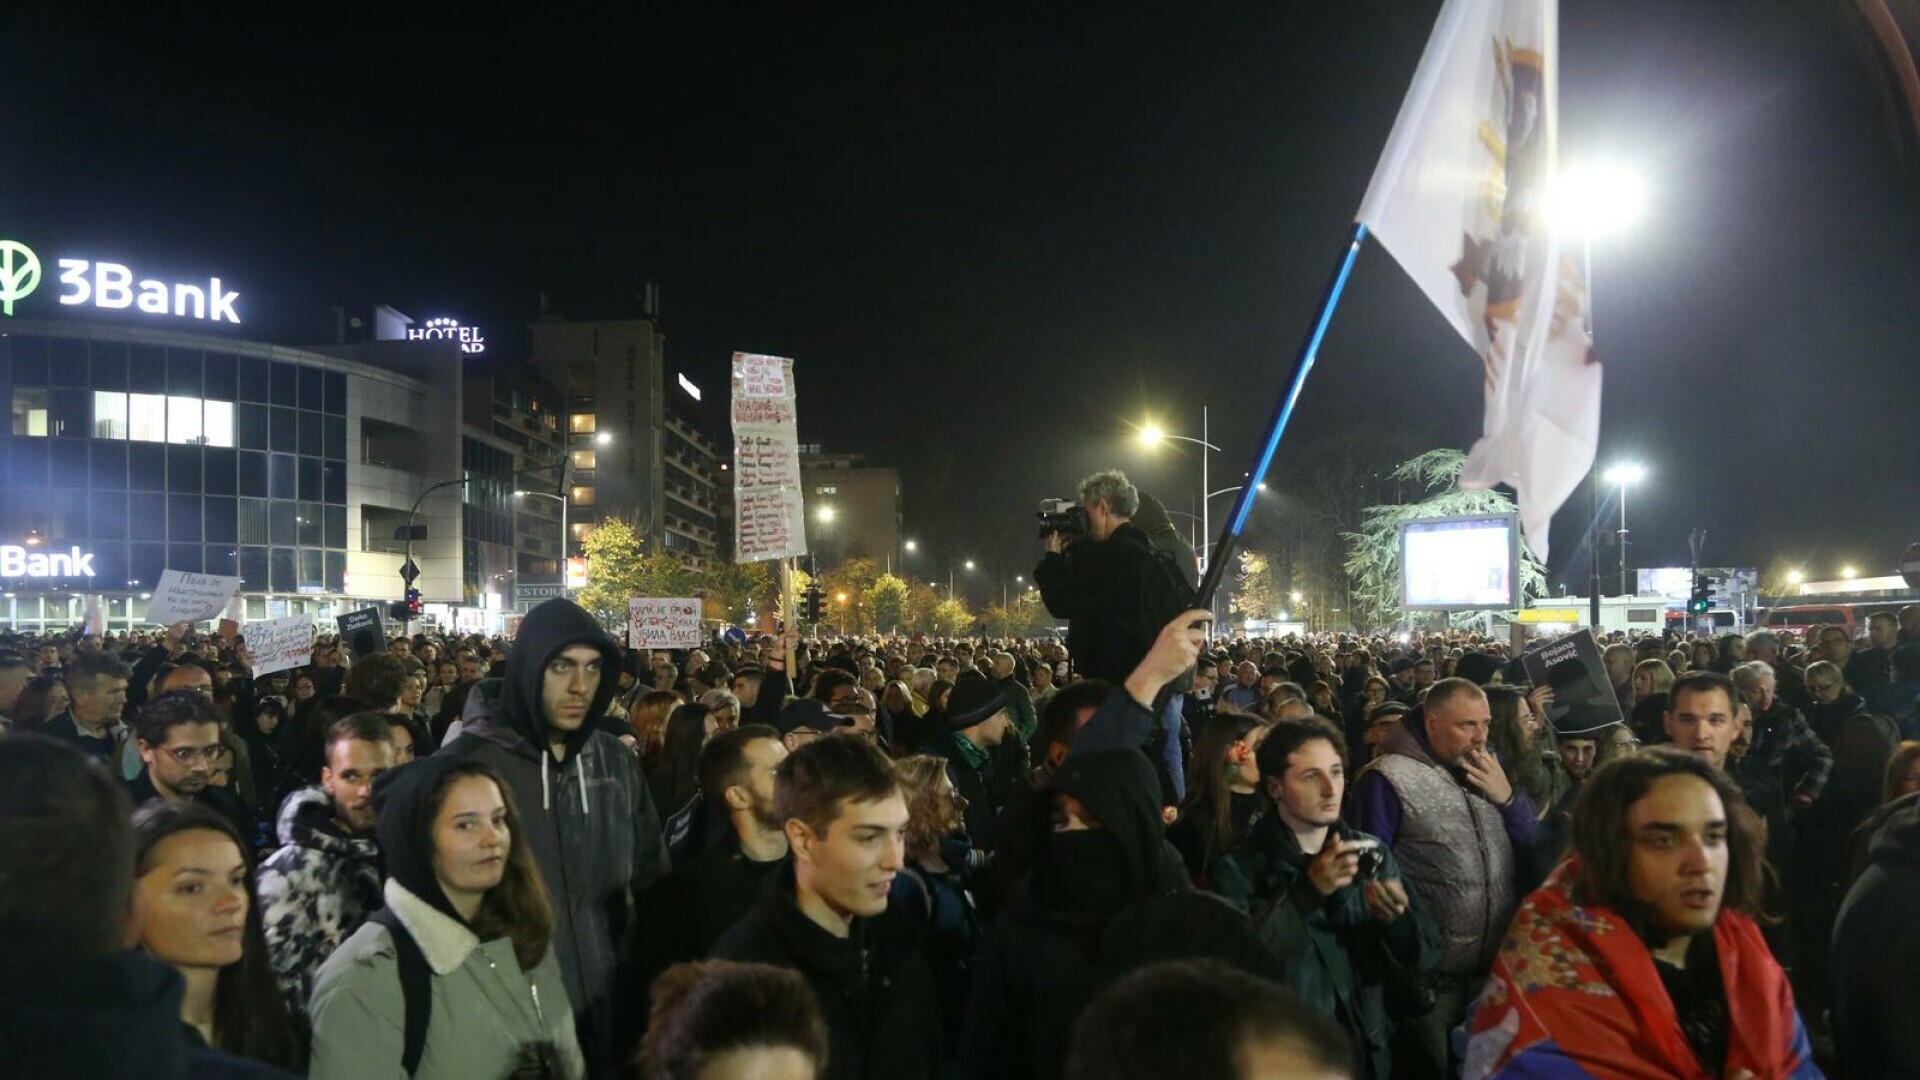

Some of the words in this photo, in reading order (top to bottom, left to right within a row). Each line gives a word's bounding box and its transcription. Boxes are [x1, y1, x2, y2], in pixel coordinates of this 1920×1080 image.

[58, 258, 240, 323] 3Bank
[408, 327, 484, 342] HOTEL
[0, 545, 96, 577] Bank
[1540, 642, 1576, 660] Bojana
[1544, 650, 1579, 668] Asović
